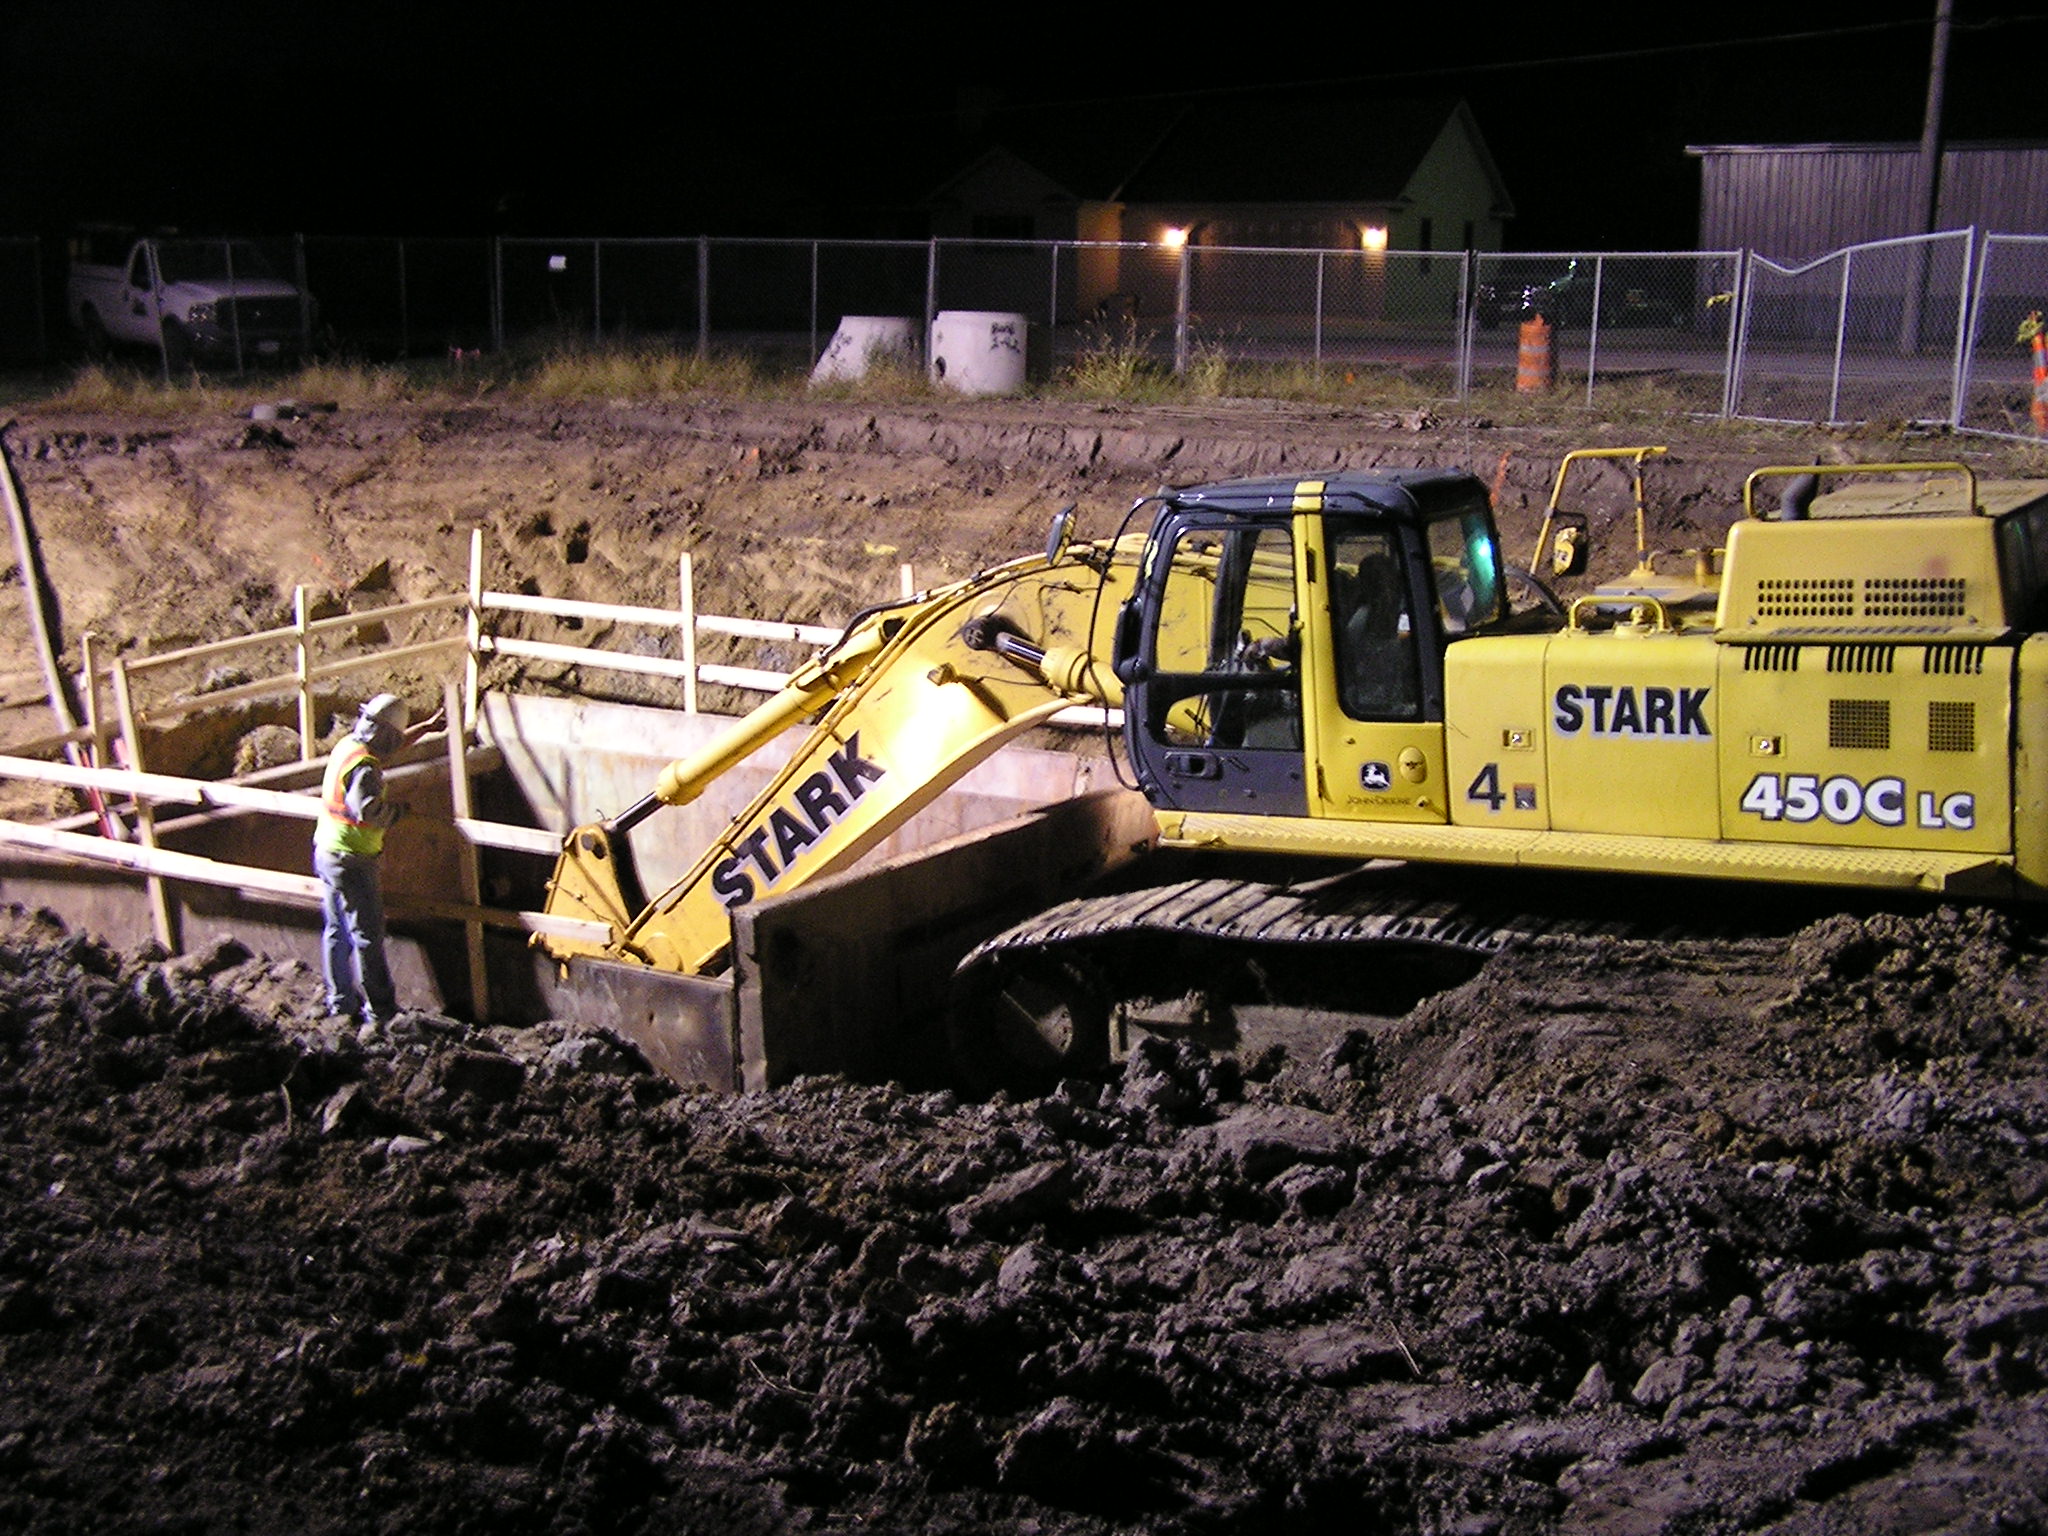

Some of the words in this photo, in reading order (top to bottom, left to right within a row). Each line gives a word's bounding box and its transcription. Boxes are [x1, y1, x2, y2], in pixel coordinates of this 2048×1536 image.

[1554, 684, 1713, 740] STARK
[1467, 763, 1506, 812] 4
[1741, 773, 1906, 828] 450C
[1917, 792, 1977, 830] LC
[712, 730, 887, 910] STARK
